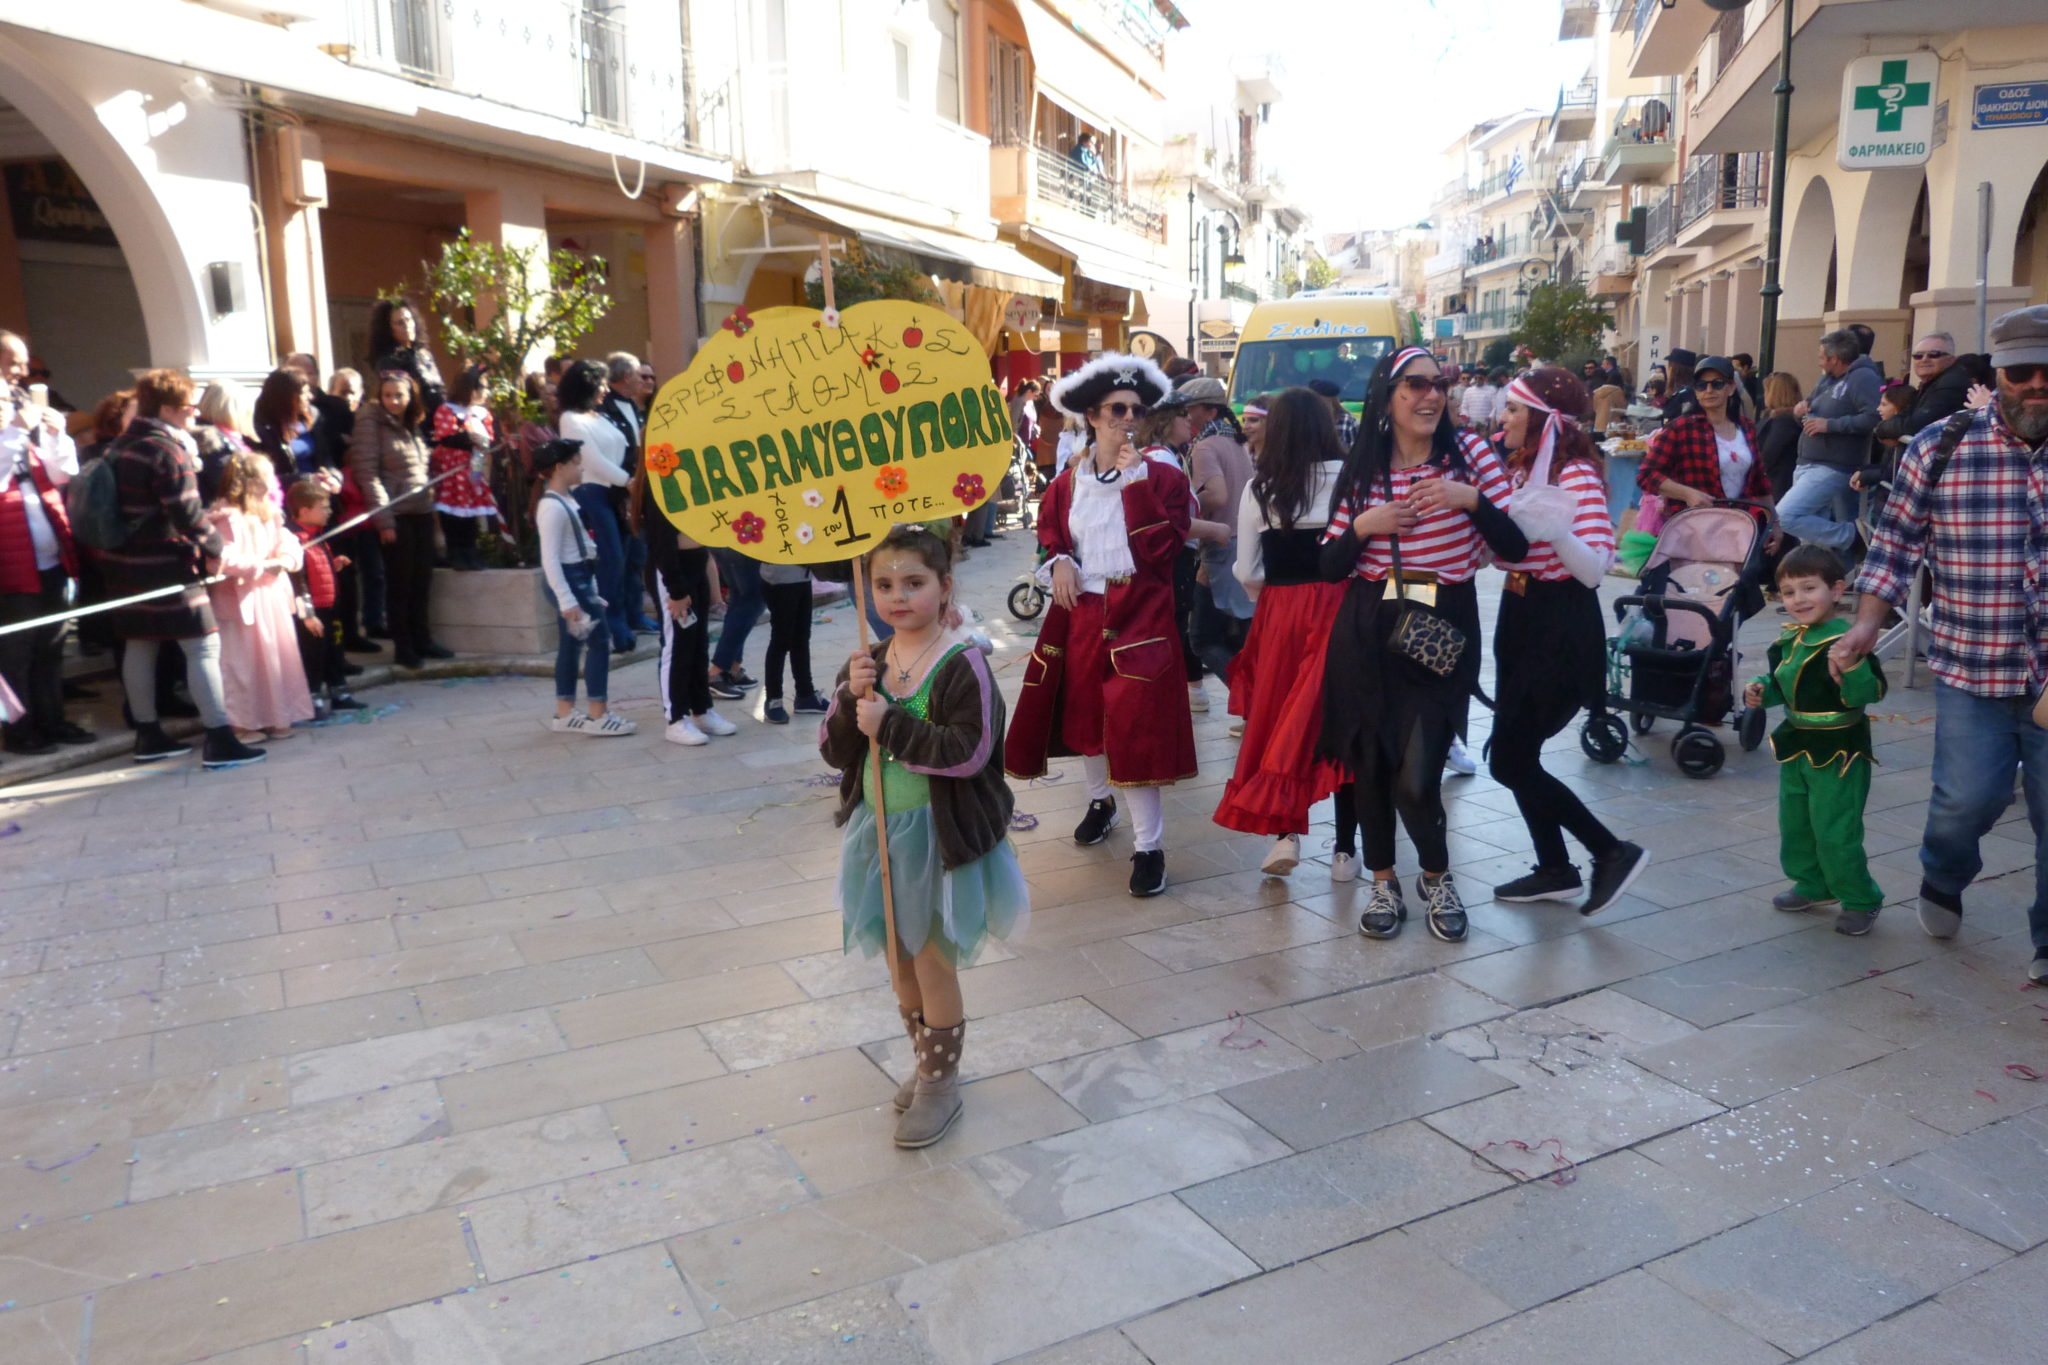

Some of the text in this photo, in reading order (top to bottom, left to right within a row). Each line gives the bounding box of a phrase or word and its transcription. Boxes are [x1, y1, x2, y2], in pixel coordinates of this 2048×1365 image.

[1999, 87, 2031, 99] ΟΔΟΣ
[1978, 102, 2024, 113] ΙΘΑΚΗΣΙΟΥ
[1848, 142, 1925, 158] ΦΑΡΜΑΚΕΙΟ
[658, 384, 1012, 514] ΠΑΡΑΜΥΘΟΥΠΟΛΗ
[832, 486, 872, 547] 1
